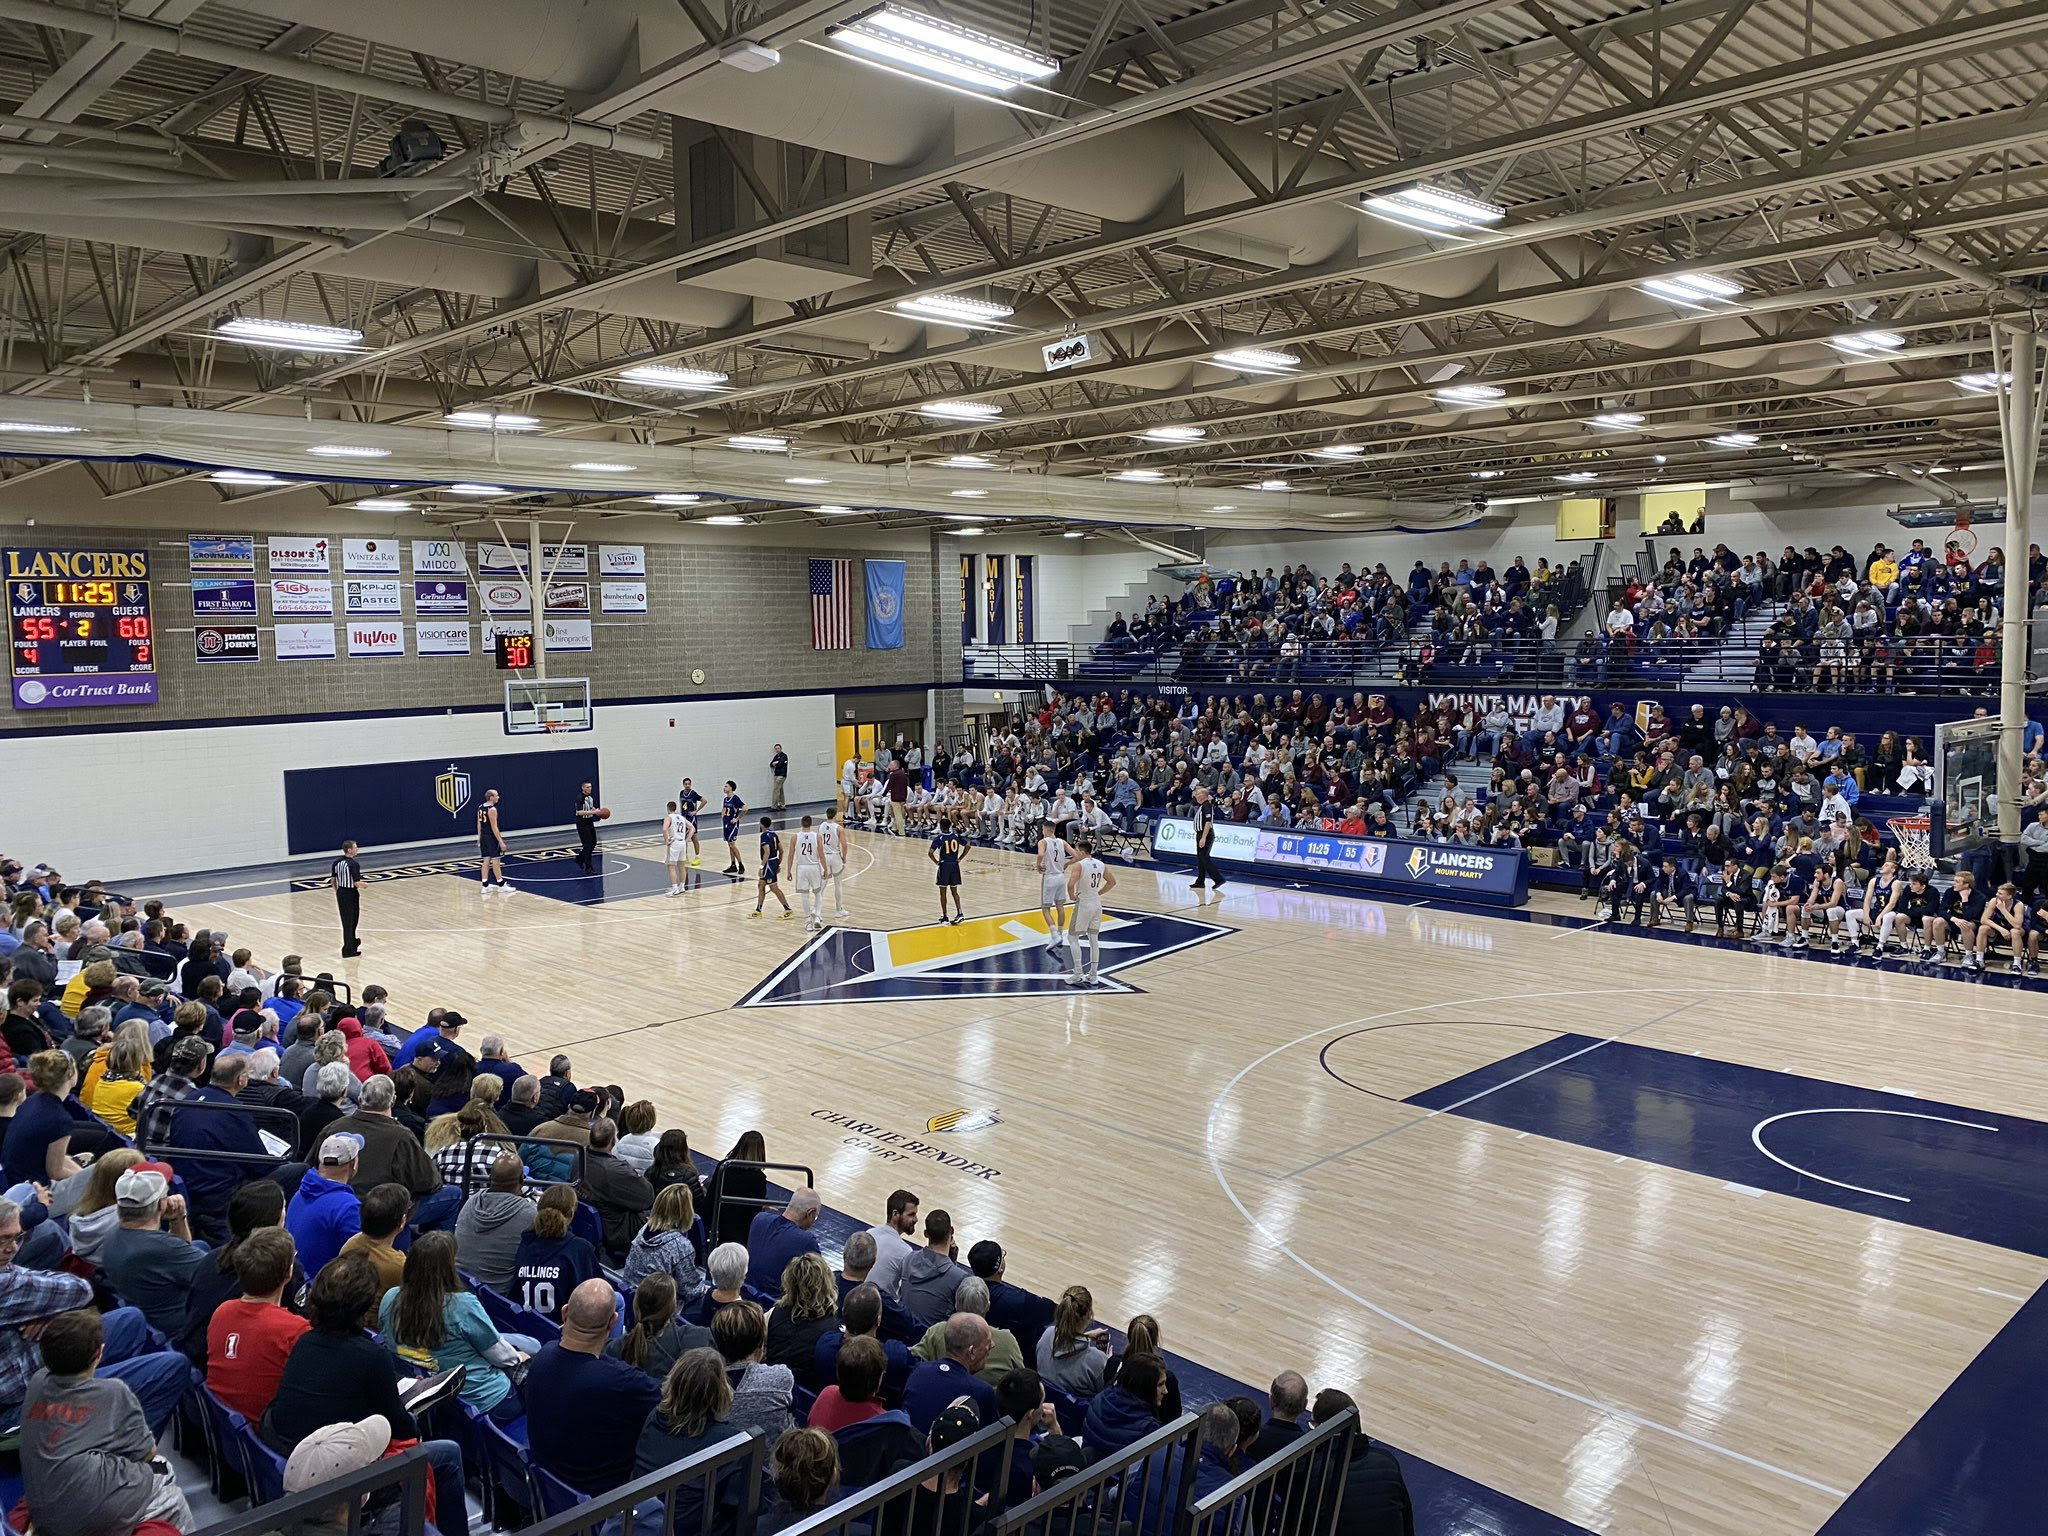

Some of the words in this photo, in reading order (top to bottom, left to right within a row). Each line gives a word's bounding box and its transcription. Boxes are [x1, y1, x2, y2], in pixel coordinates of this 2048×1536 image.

[271, 550, 315, 558] OLSON'S
[7, 551, 146, 577] LANCERS
[422, 560, 457, 569] MIDCO
[56, 583, 114, 603] 11:25
[986, 558, 998, 622] MARTY
[1016, 559, 1024, 643] LANCERS
[13, 607, 61, 617] LANCERS
[112, 607, 145, 615] GUEST
[22, 618, 55, 640] 55
[77, 619, 90, 637] 2
[119, 617, 148, 638] 60
[504, 637, 531, 647] 11:25
[552, 635, 590, 643] chiropractic
[24, 649, 37, 663] 4
[137, 646, 149, 662] 2
[507, 648, 528, 666] 30
[51, 684, 114, 698] CorTrust
[117, 683, 151, 695] Bank
[1158, 686, 1188, 695] VISITOR
[823, 833, 831, 846] 12
[945, 838, 958, 854] 10
[1233, 835, 1255, 847] Bank
[1282, 841, 1293, 851] 60
[801, 843, 813, 856] 24
[1054, 850, 1059, 862] 2
[1307, 842, 1330, 856] 11:25
[1345, 847, 1357, 858] 55
[1430, 852, 1494, 870] LANCERS
[1434, 868, 1458, 876] MOUNT
[1459, 871, 1483, 879] MARTY
[810, 1109, 906, 1148] CHARLIE
[899, 1140, 1002, 1180] BENDER
[843, 1137, 909, 1162] COURT
[518, 1266, 560, 1279] BILLINGS
[522, 1281, 555, 1313] 10
[225, 1333, 240, 1359] 1
